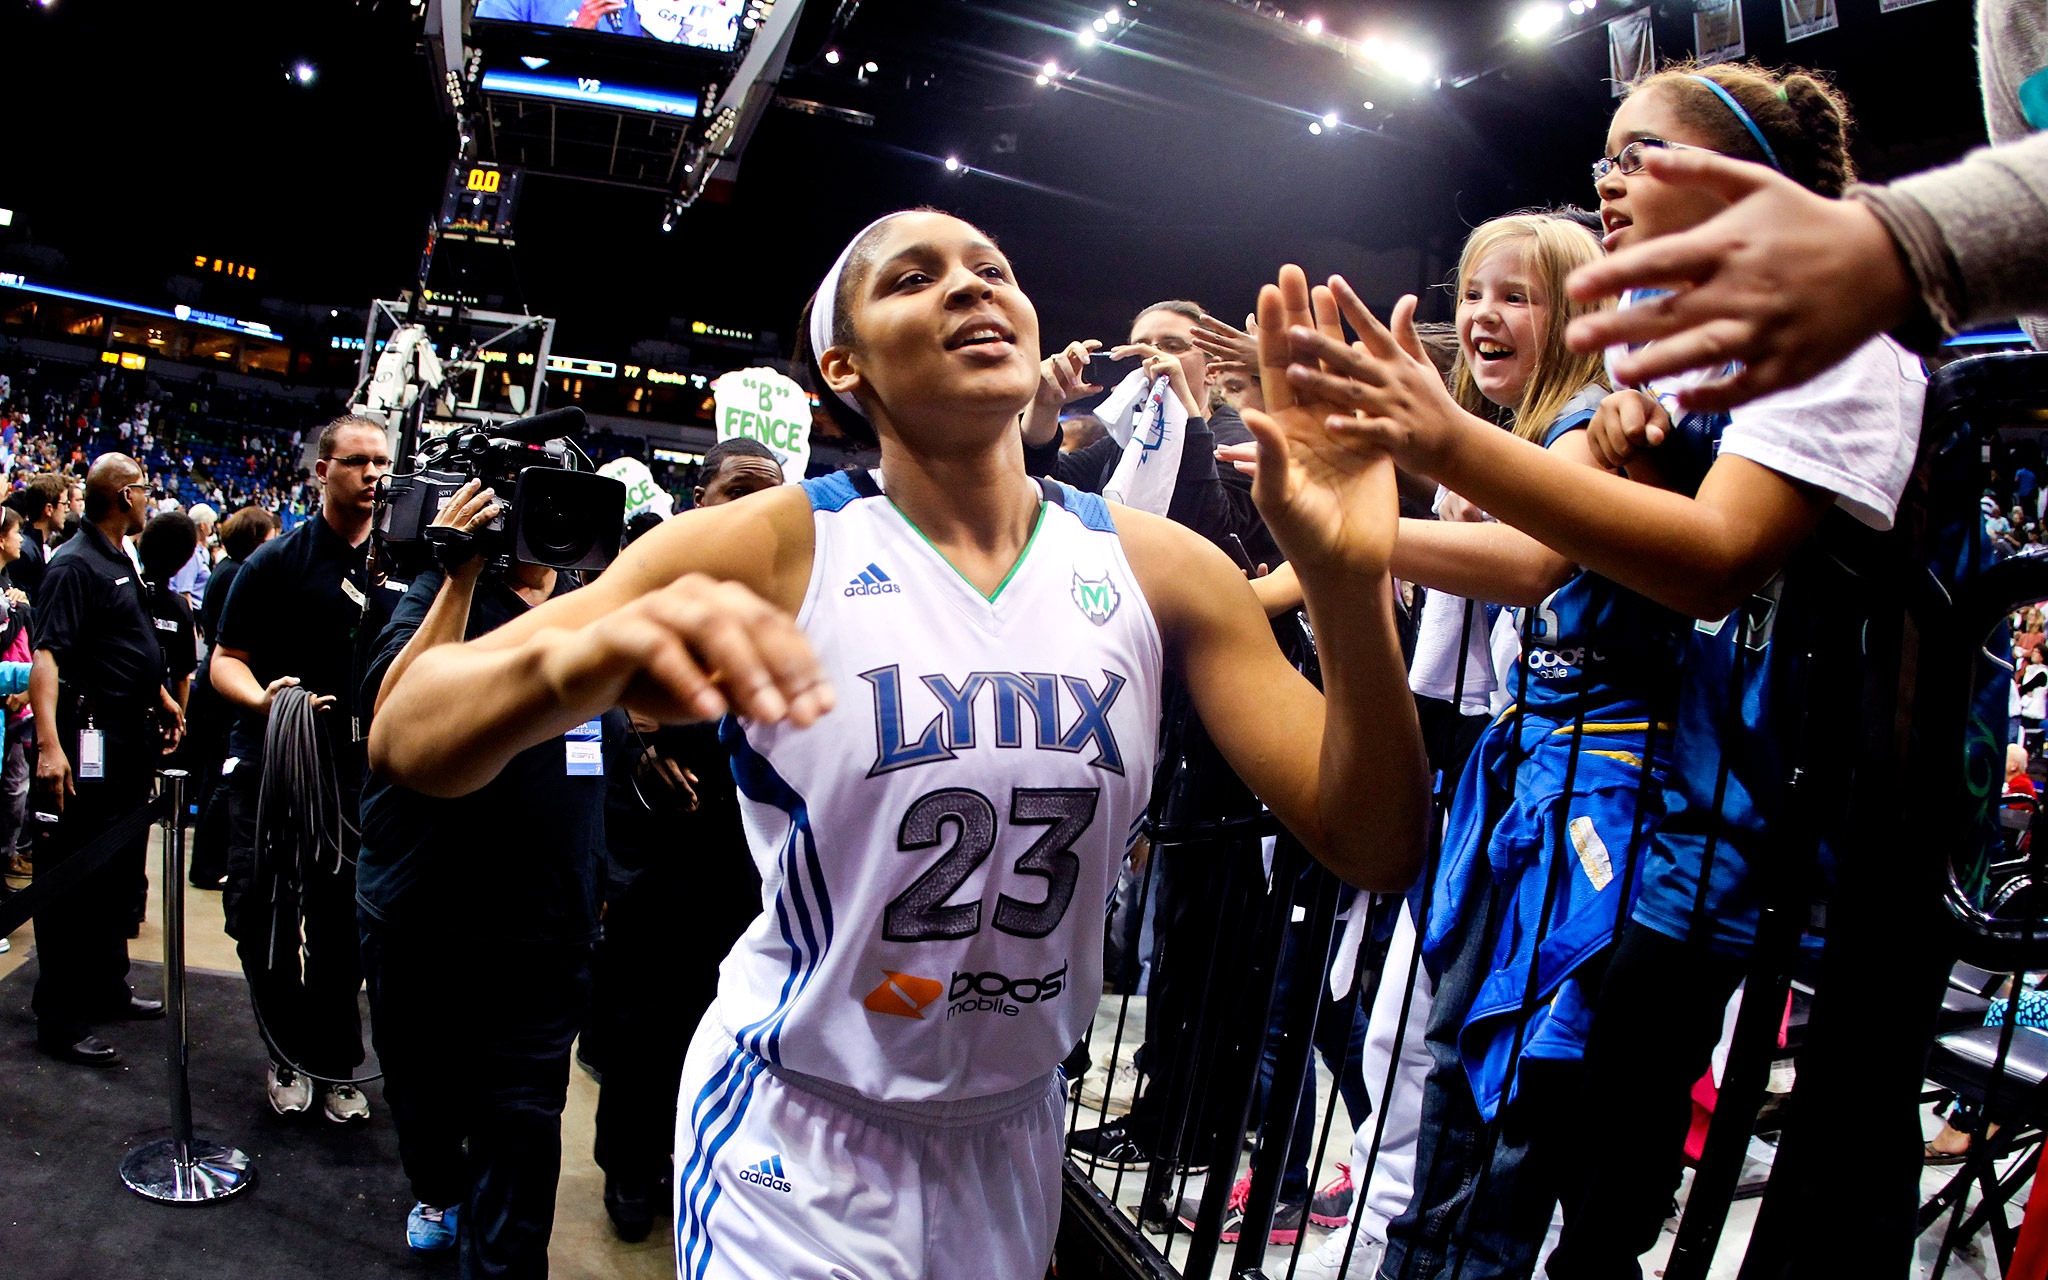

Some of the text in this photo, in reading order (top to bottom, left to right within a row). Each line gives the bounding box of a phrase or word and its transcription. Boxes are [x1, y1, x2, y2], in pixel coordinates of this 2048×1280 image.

[578, 78, 601, 93] VS
[467, 169, 500, 192] 0.0
[624, 365, 641, 378] 77
[725, 406, 802, 453] FENCE
[438, 489, 452, 497] SONY
[844, 582, 901, 597] adidas
[1537, 667, 1568, 679] obile
[857, 664, 1127, 780] LYNX
[881, 787, 1101, 943] 23
[948, 959, 1068, 1003] boost
[947, 997, 1020, 1021] mobile
[739, 1169, 792, 1193] adidas
